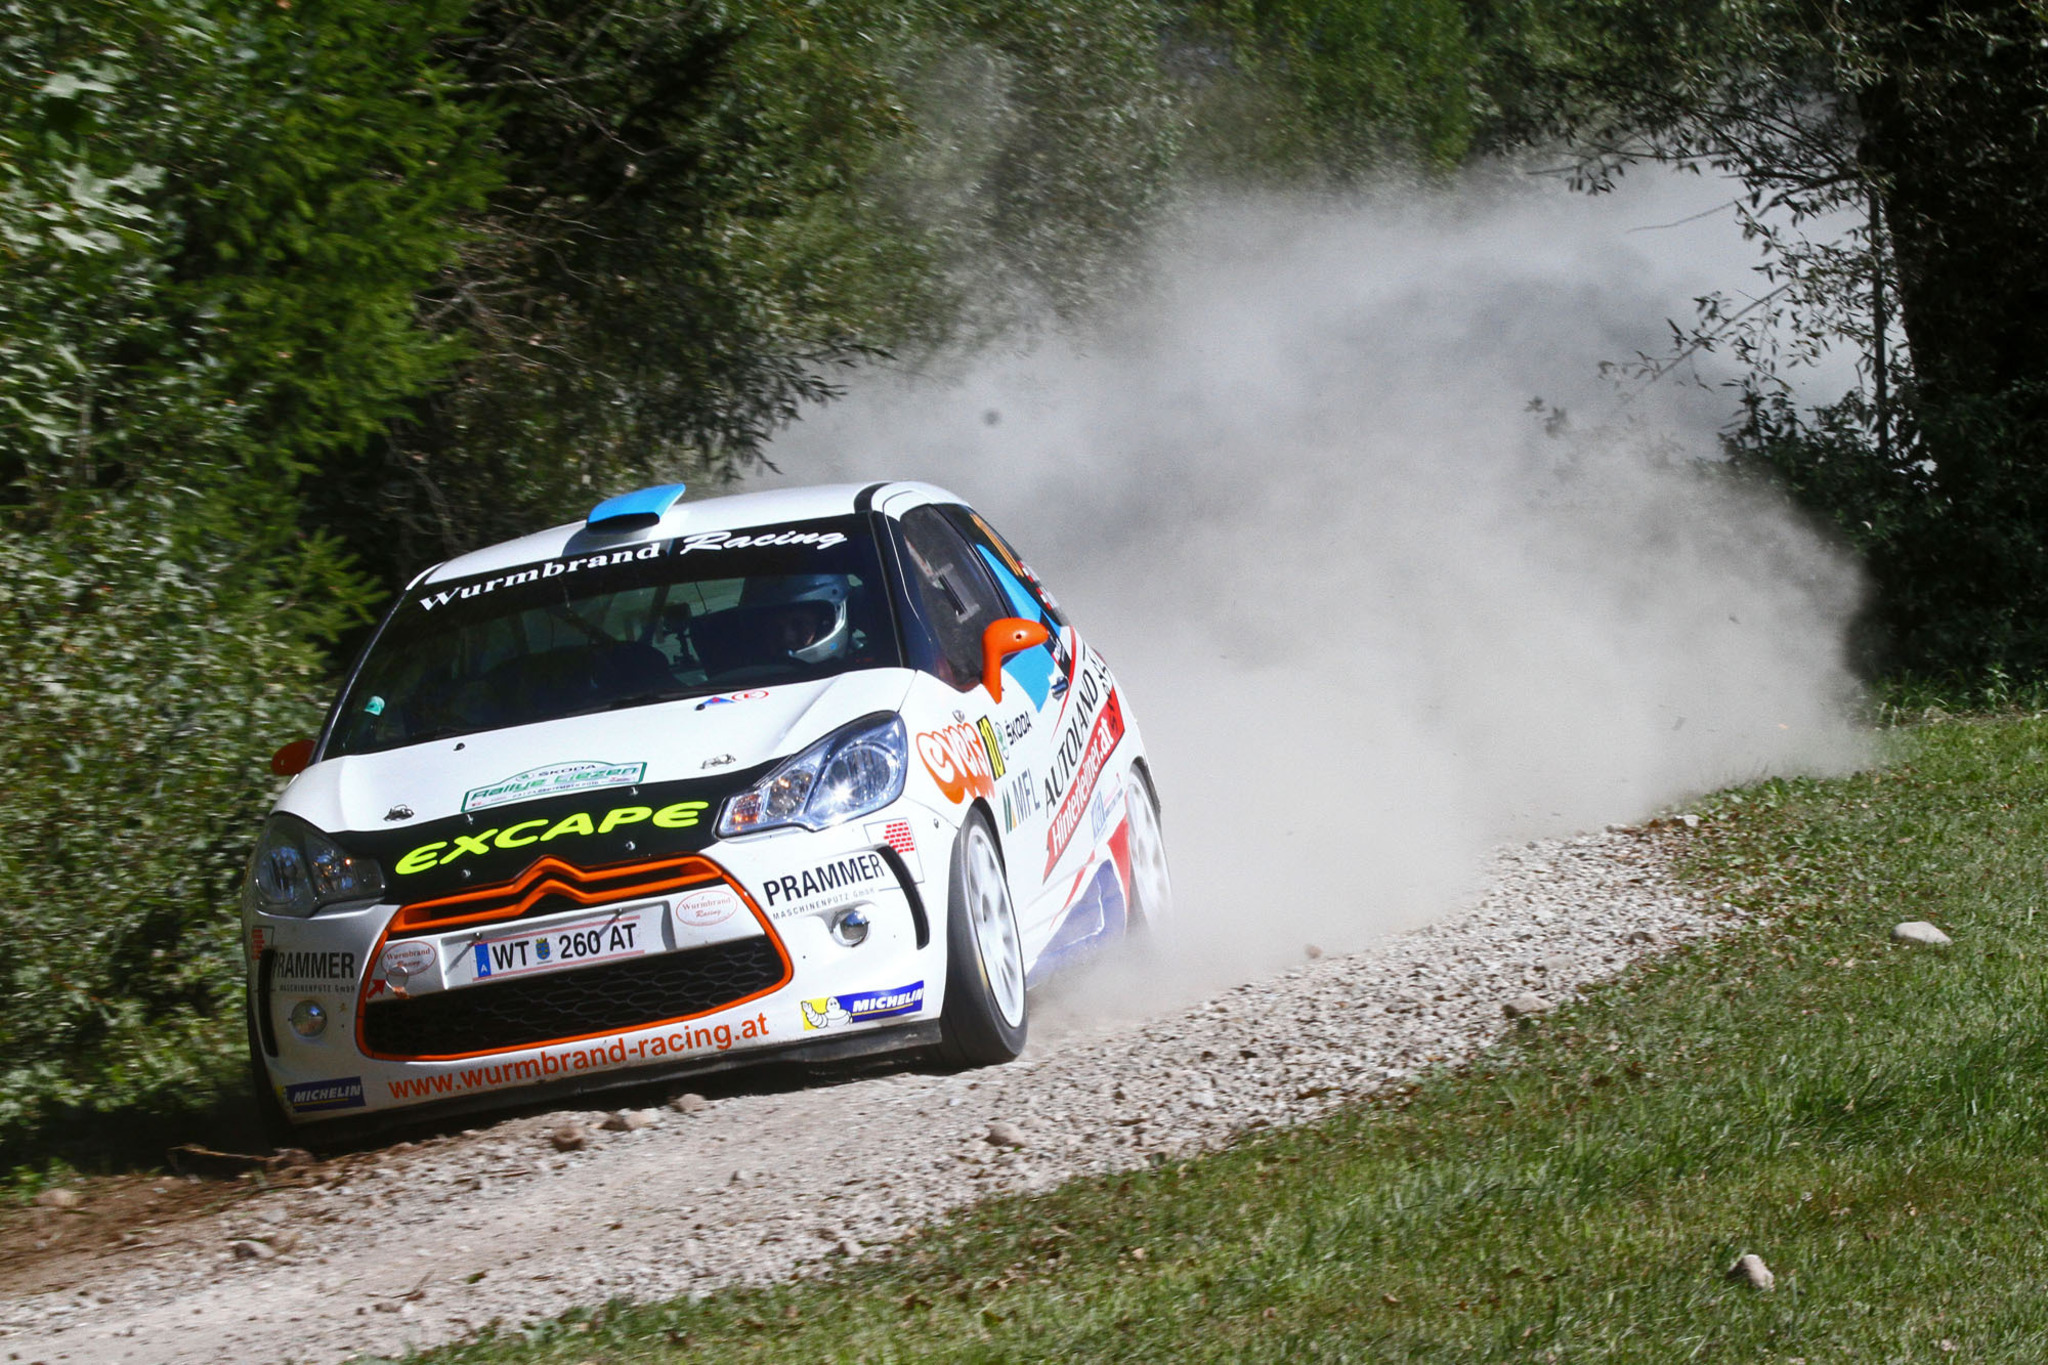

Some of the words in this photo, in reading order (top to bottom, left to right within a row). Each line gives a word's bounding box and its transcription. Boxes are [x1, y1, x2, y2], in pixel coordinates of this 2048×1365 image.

[419, 542, 661, 611] Wurmbrand
[680, 530, 848, 555] Racing
[1044, 669, 1098, 819] AUTOLAND
[471, 778, 546, 801] Rallye
[554, 767, 639, 785] Liezen
[1012, 768, 1040, 824] MFL
[395, 801, 709, 875] EXCAPE
[763, 853, 885, 907] PRAMMER
[773, 893, 850, 920] MASCHINENPUTZ
[492, 940, 530, 970] WT
[558, 930, 601, 959] 260
[609, 923, 637, 952] AT
[852, 987, 924, 1013] MICHELIN
[388, 1012, 769, 1099] www.wurmbrand-racing.at
[294, 1084, 361, 1103] MICHELIN
